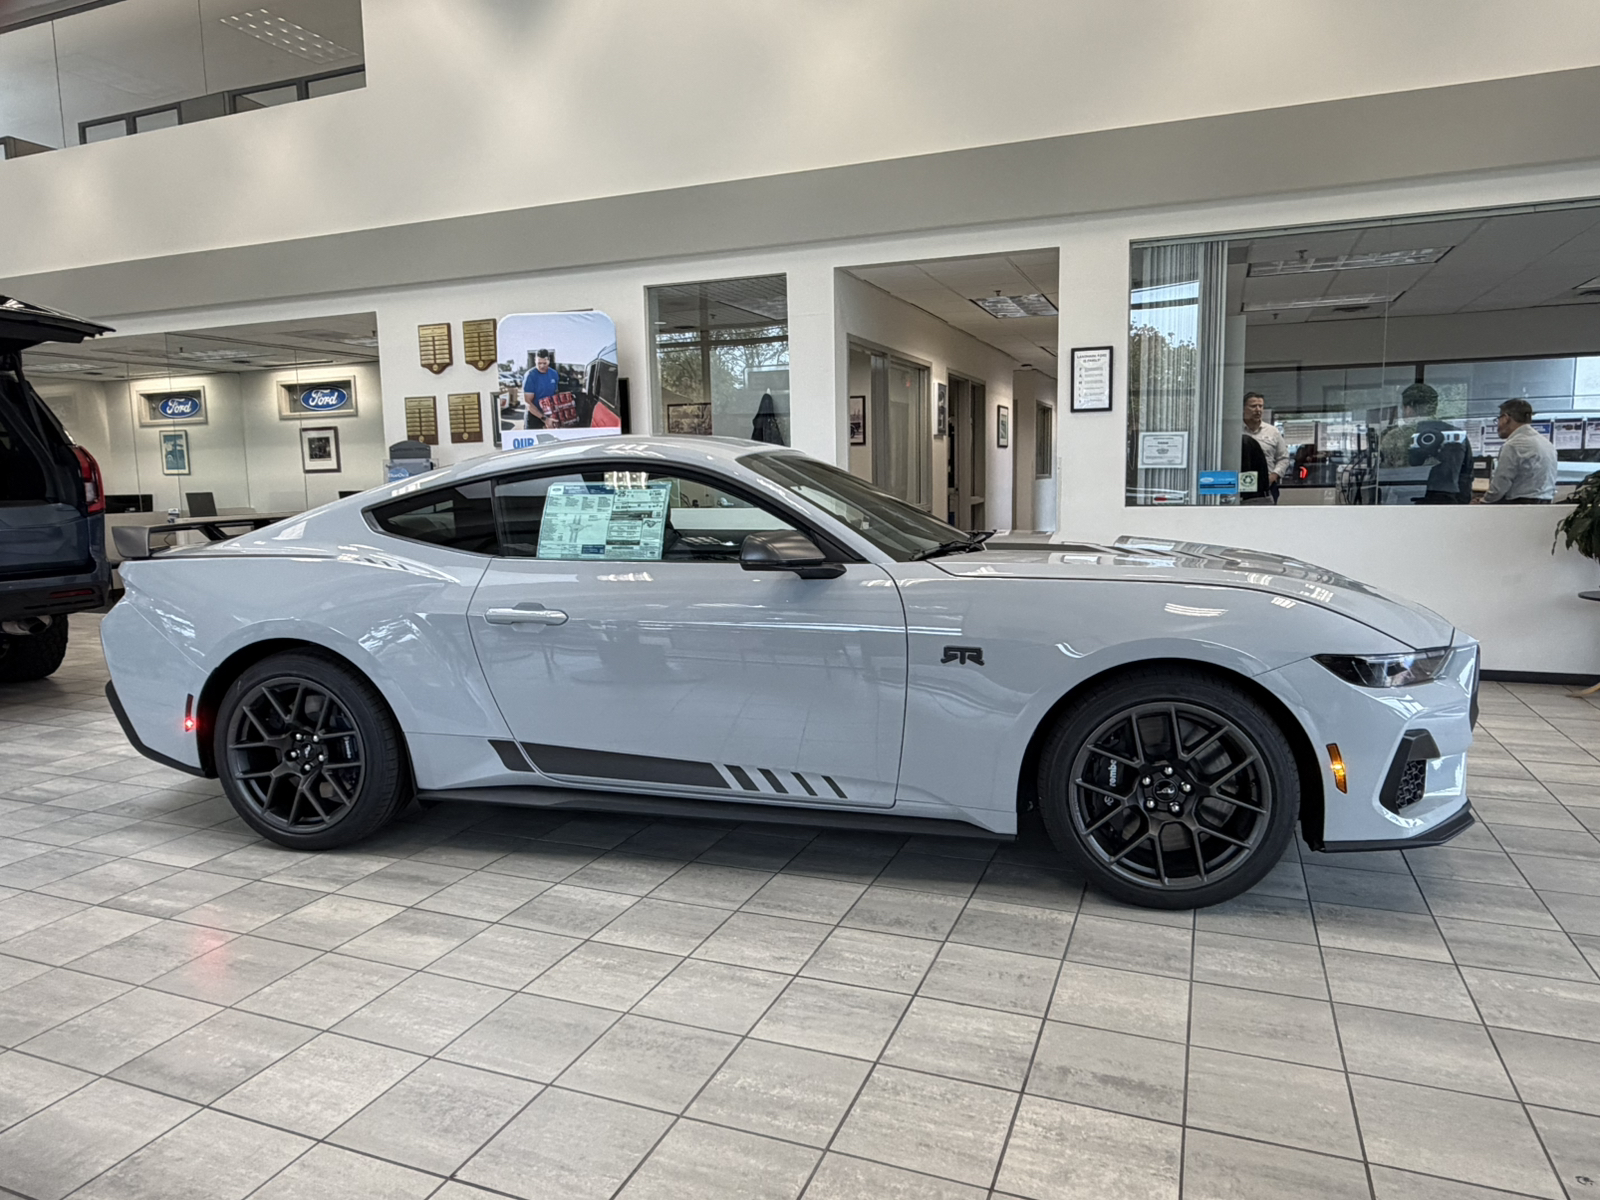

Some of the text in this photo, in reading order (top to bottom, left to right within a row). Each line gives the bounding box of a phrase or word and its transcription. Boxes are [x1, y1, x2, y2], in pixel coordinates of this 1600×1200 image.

[309, 389, 338, 406] Ford
[166, 398, 191, 414] Ford
[513, 438, 535, 449] OUR
